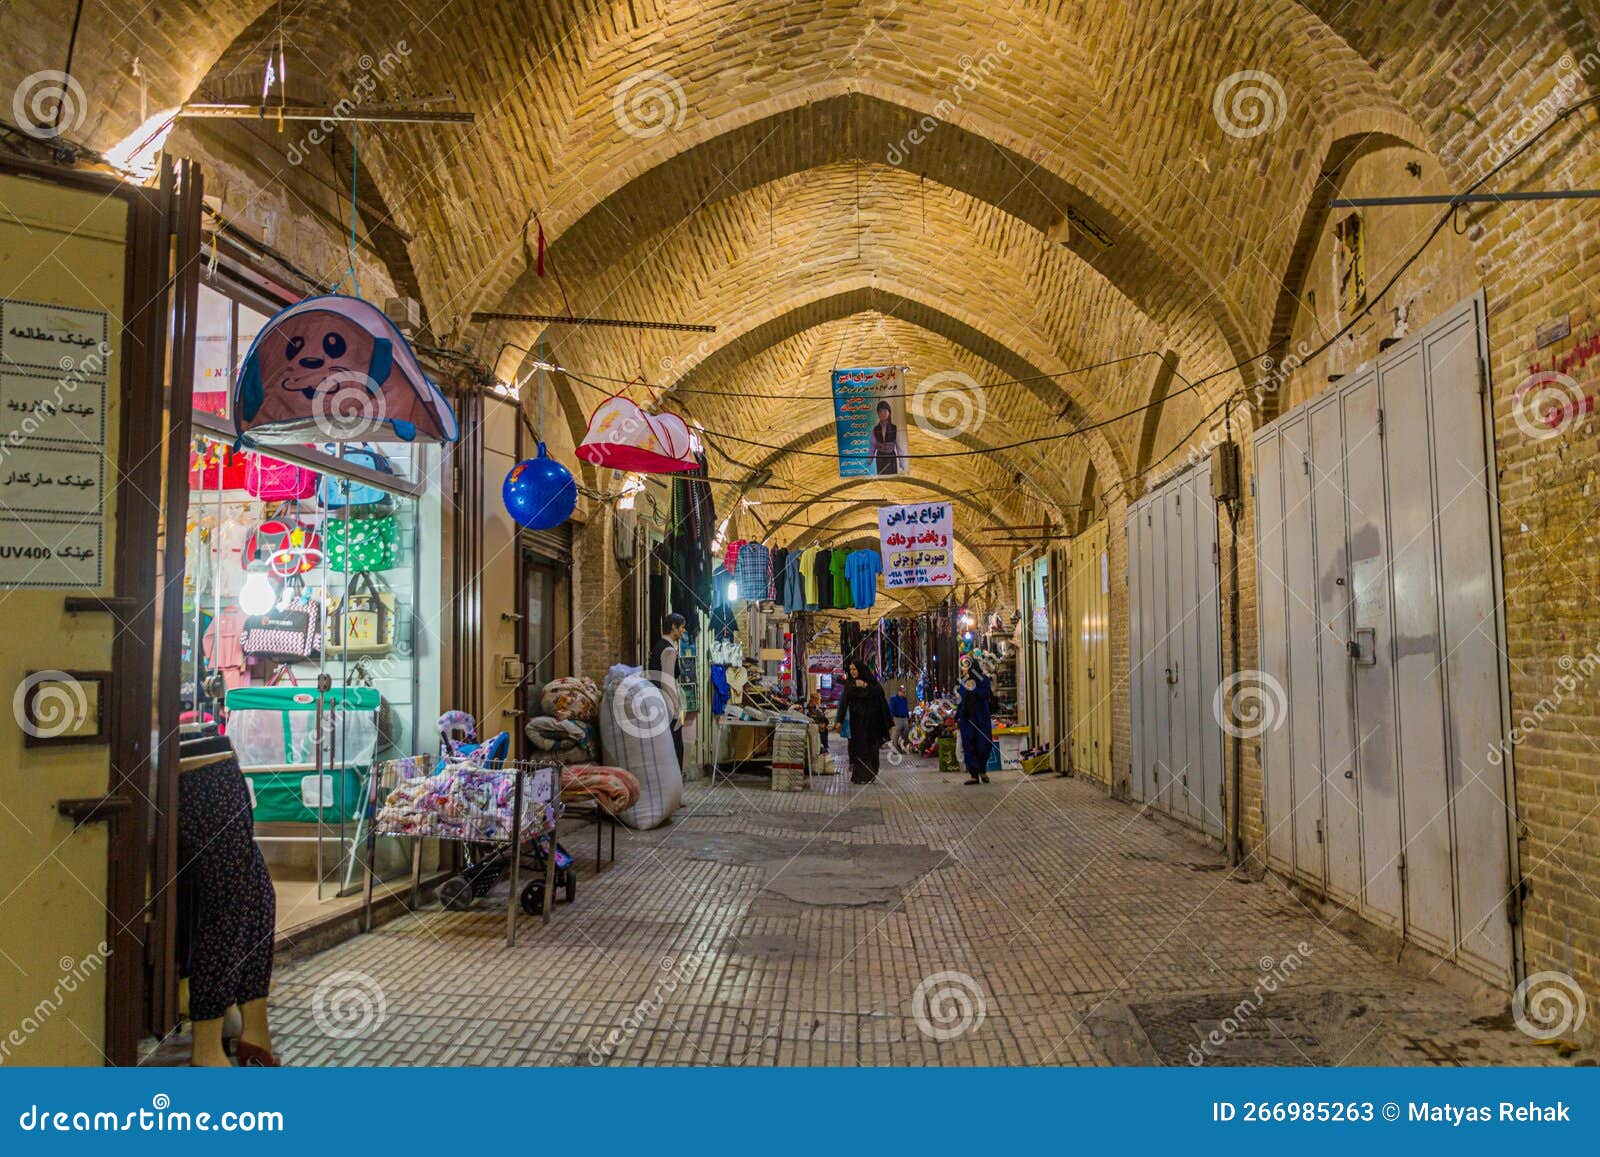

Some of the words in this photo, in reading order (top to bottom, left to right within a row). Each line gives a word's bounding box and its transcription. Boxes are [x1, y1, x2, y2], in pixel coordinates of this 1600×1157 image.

[9, 327, 55, 342] مطالعه
[59, 333, 97, 349] عینک
[61, 403, 95, 417] عینک
[3, 471, 52, 487] مارکدار
[57, 475, 95, 489] عینک
[887, 508, 918, 526] پیراهن
[919, 506, 945, 524] انواع
[887, 533, 916, 549] مردانه
[918, 530, 939, 547] بافت
[941, 534, 948, 547] و
[0, 546, 52, 560] UV400
[57, 546, 95, 561] عینک
[924, 553, 945, 566] بصورت
